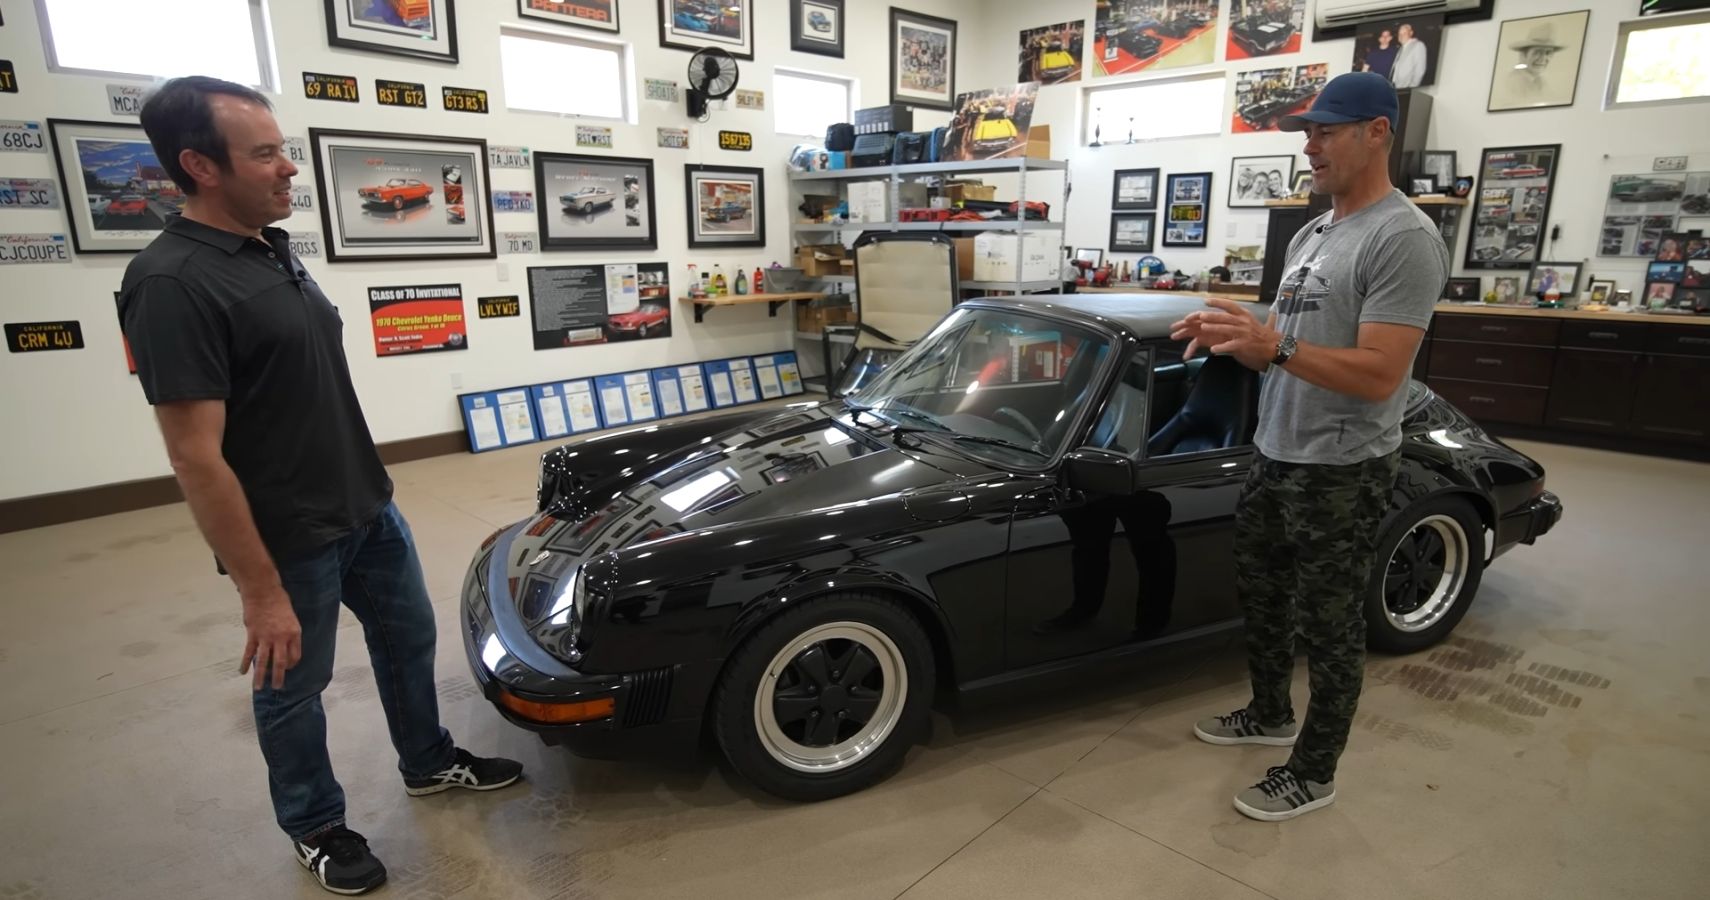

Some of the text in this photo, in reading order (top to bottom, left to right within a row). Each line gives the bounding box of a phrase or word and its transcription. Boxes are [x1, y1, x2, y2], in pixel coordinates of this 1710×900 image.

[531, 0, 607, 21] PANTERA
[307, 82, 321, 96] 69
[379, 89, 424, 105] RST GT2
[3, 132, 43, 149] 68CJ
[370, 289, 395, 300] CLASS
[404, 288, 415, 299] 70
[416, 287, 460, 298] INVITATIONAL
[376, 317, 391, 327] 1970
[392, 315, 423, 326] Chevrolet
[18, 331, 73, 348] CRM 4U
